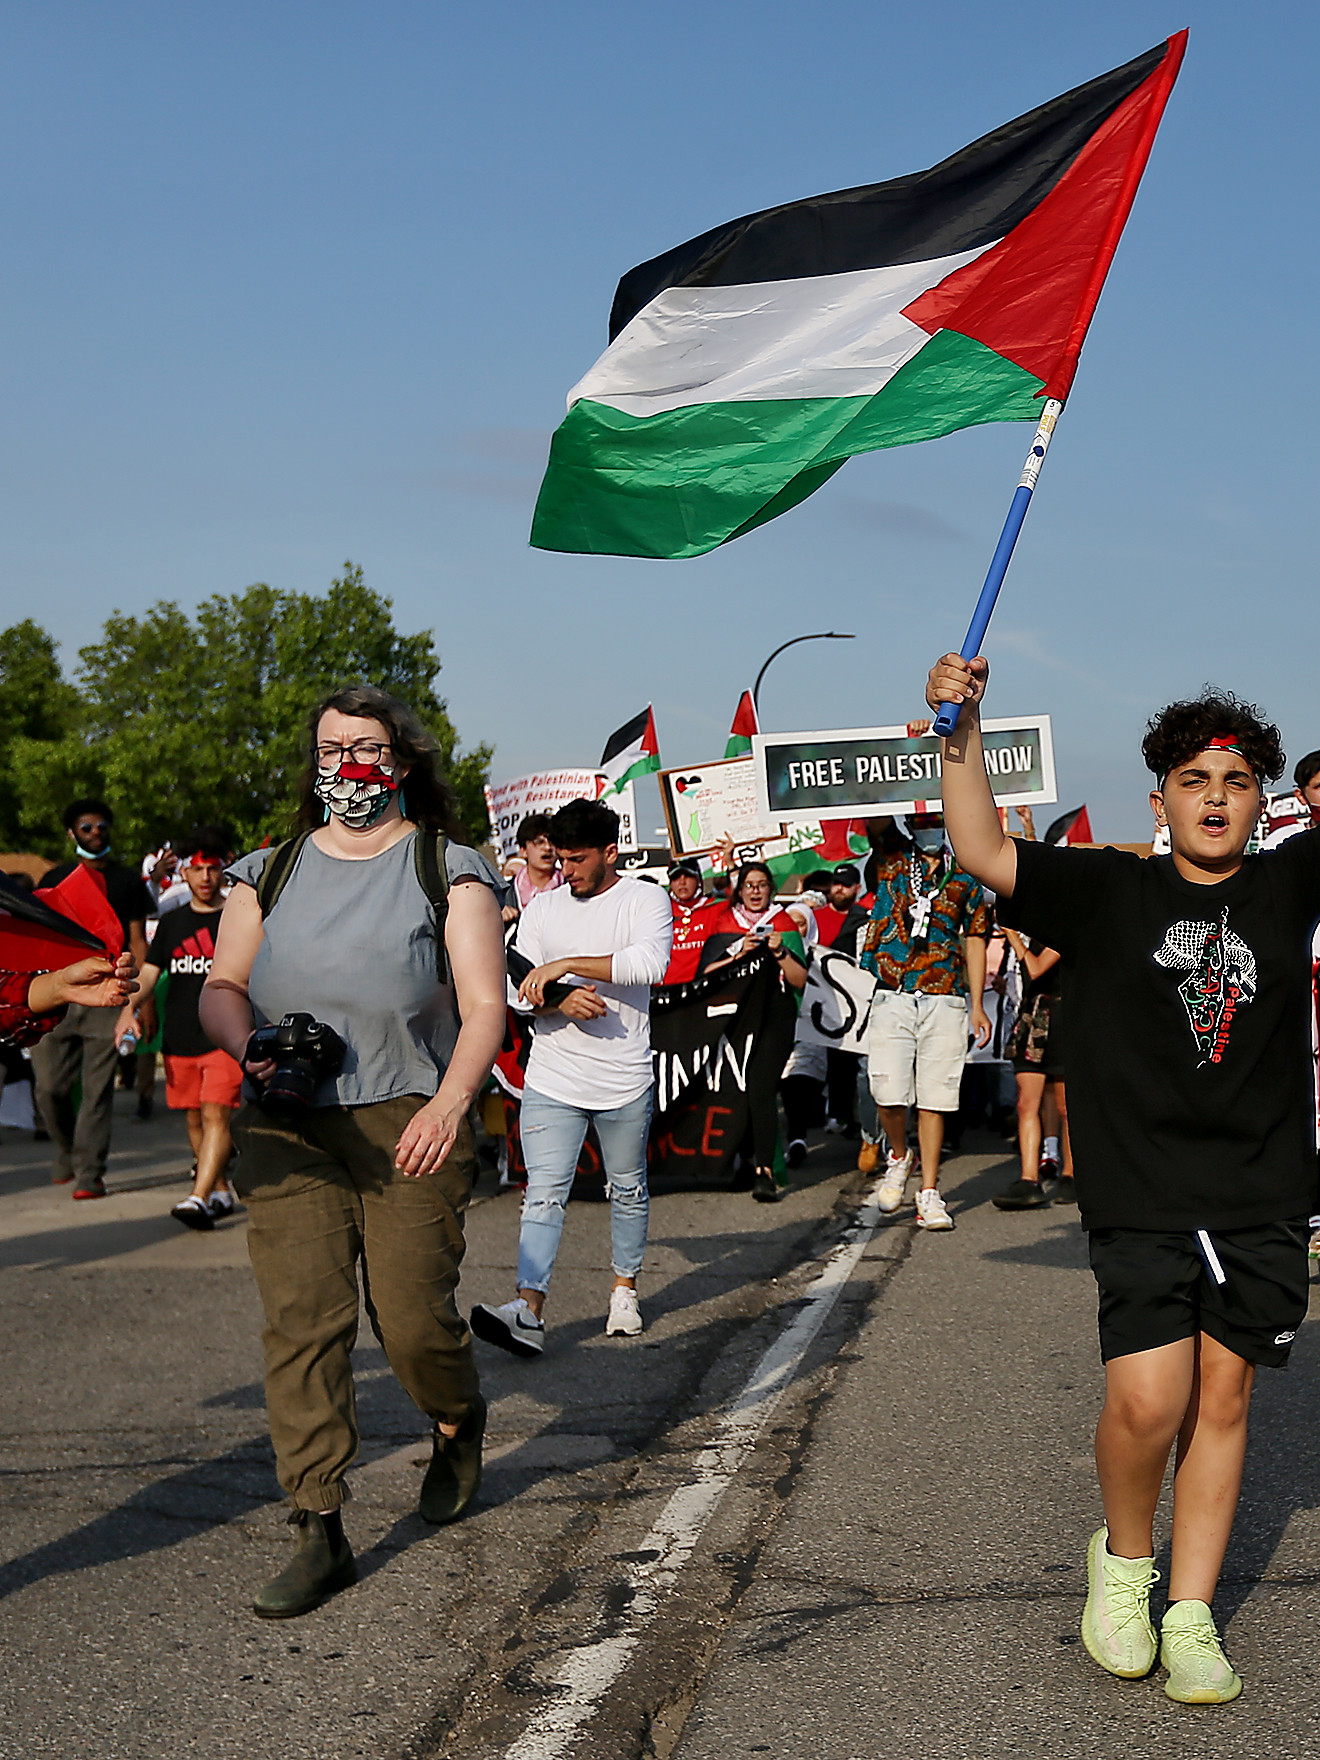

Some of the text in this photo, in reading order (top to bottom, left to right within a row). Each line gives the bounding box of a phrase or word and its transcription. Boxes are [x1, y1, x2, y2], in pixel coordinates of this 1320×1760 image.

[530, 773, 591, 788] Palestinian
[788, 758, 845, 789] FREE
[855, 752, 942, 783] PALESTI
[984, 745, 1033, 775] NOW
[525, 788, 594, 804] Resistance!
[1211, 986, 1241, 1064] Palestine
